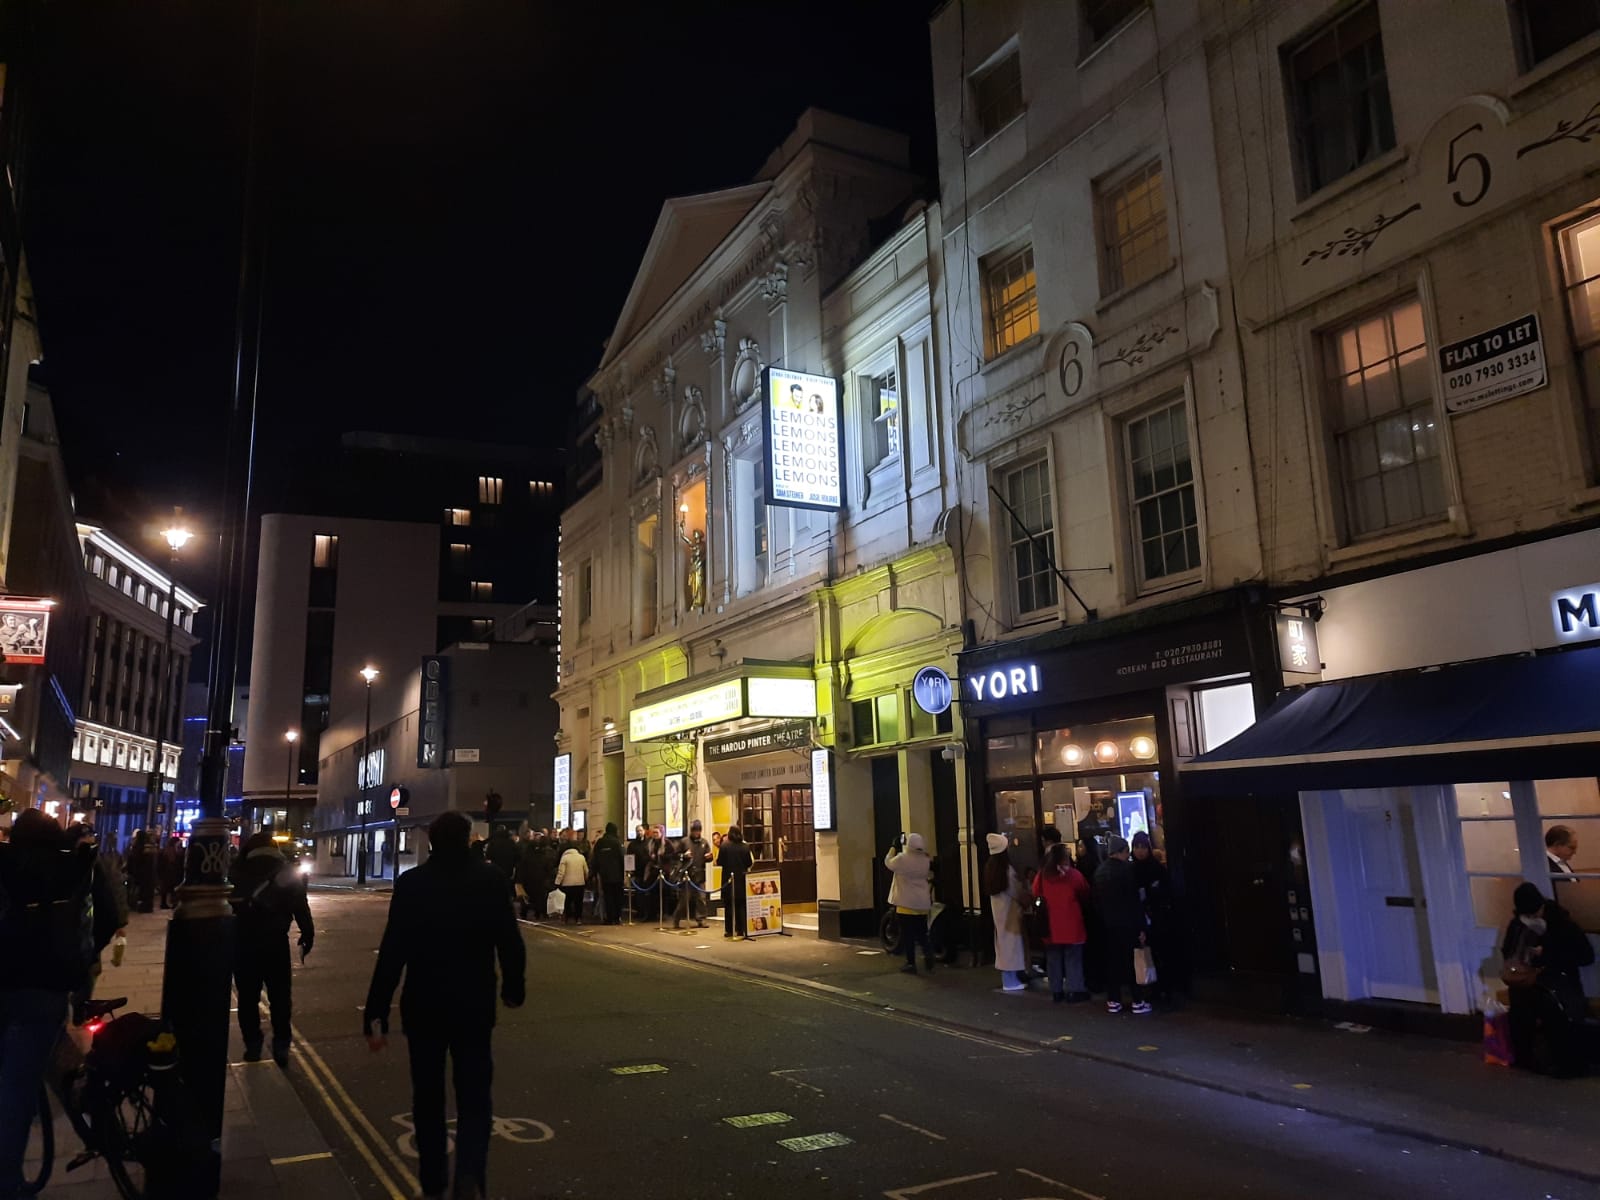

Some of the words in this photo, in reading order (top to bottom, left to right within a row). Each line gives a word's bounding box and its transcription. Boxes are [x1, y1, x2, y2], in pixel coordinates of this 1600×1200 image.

[1448, 123, 1491, 207] 5
[1445, 343, 1479, 367] FLAT
[1483, 334, 1503, 353] TO
[1507, 322, 1532, 344] LET
[1060, 341, 1083, 397] 6
[1450, 373, 1472, 389] 020
[1476, 361, 1504, 382] 7930
[1507, 349, 1537, 370] 3334
[772, 408, 836, 429] LEMONS
[773, 424, 836, 444] LEMONS
[773, 438, 837, 458] LEMONS
[774, 453, 837, 472] LEMONS
[775, 468, 838, 488] LEMONS
[1171, 648, 1223, 666] RESTAURANT
[921, 677, 945, 690] YORI
[970, 664, 1039, 701] YORI
[709, 746, 721, 756] THE
[720, 740, 746, 754] HAROLD
[747, 735, 771, 748] PINTER
[773, 728, 804, 744] THEATRE
